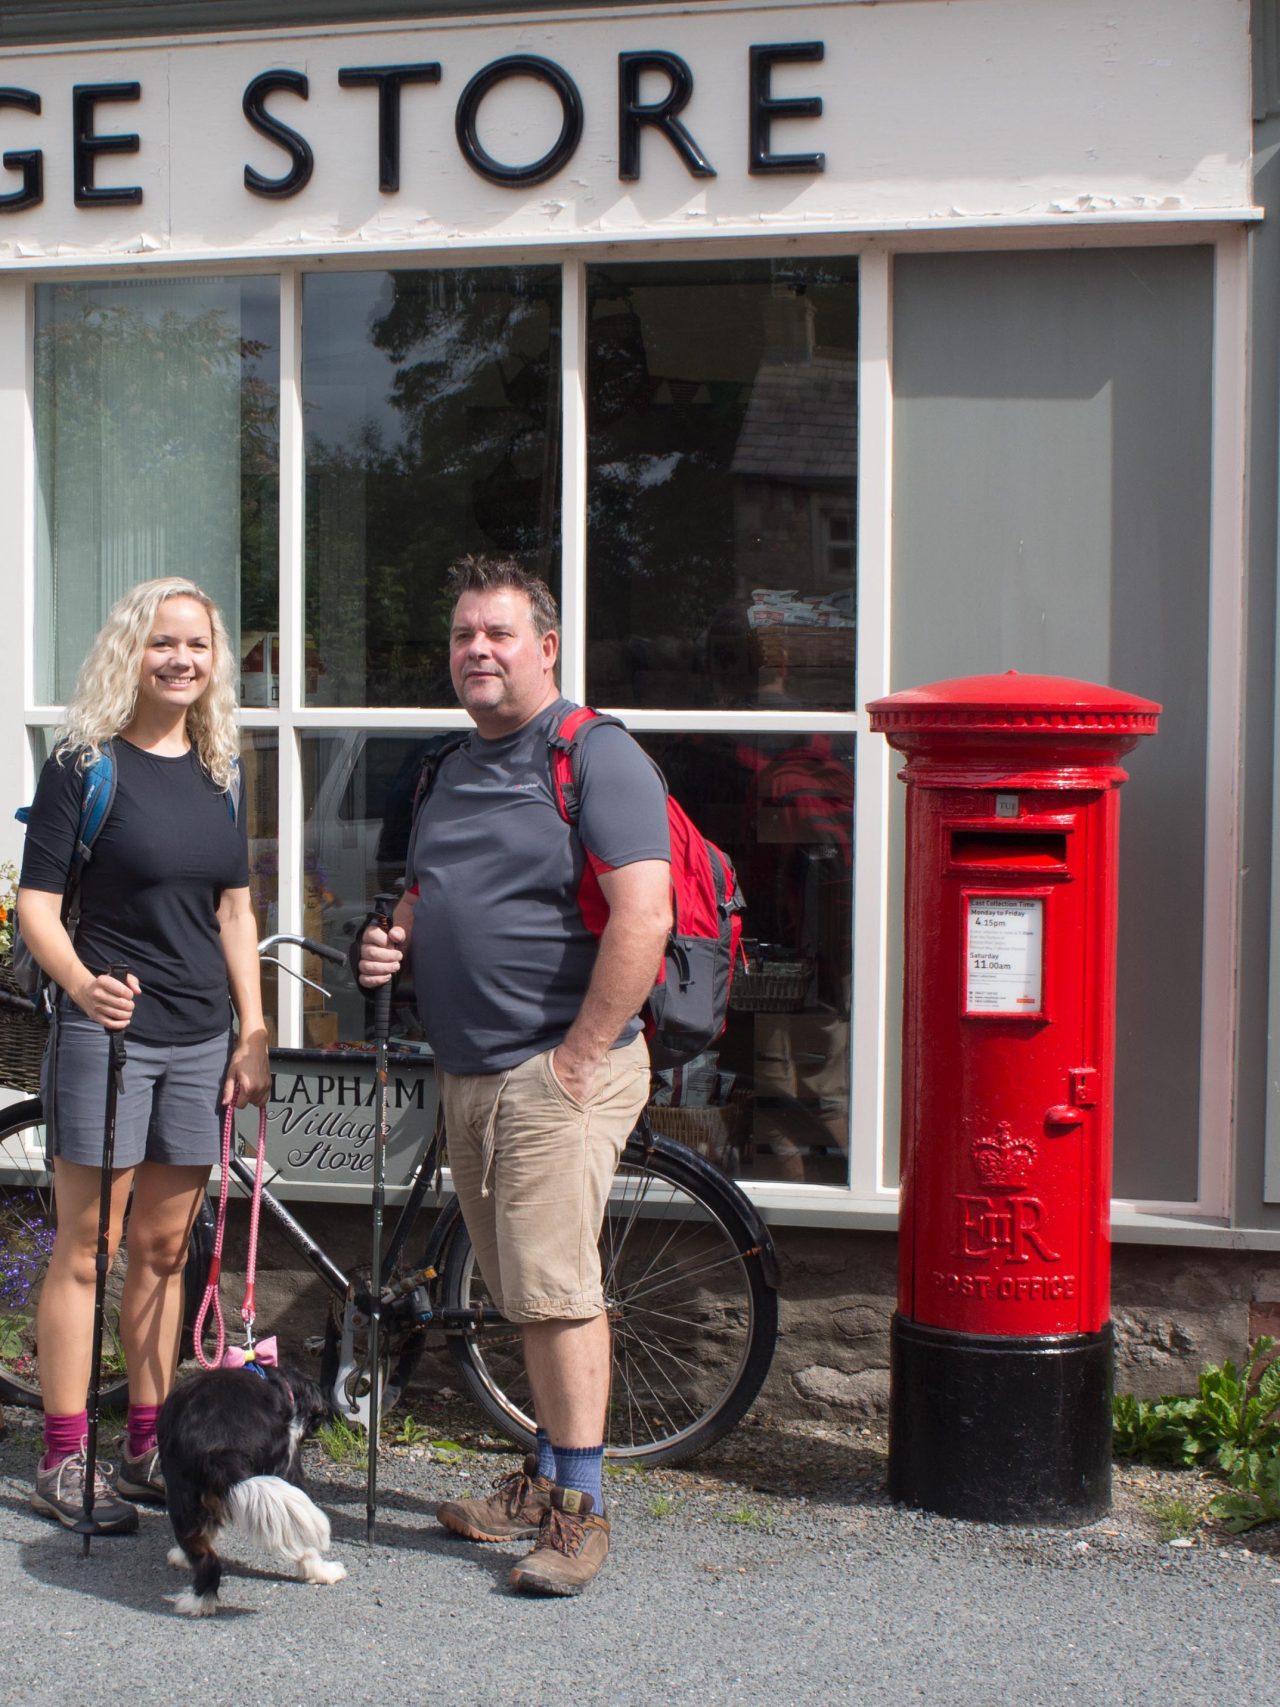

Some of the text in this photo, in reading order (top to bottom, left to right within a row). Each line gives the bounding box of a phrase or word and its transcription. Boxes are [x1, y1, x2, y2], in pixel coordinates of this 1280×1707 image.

[242, 40, 825, 200] STORE
[986, 900, 1017, 908] Collection
[970, 910, 995, 918] Monday
[1005, 910, 1026, 918] Friday
[969, 952, 999, 961] Saturday
[267, 1073, 425, 1110] LAPHAM
[933, 1271, 1076, 1301] POST OFFICE
